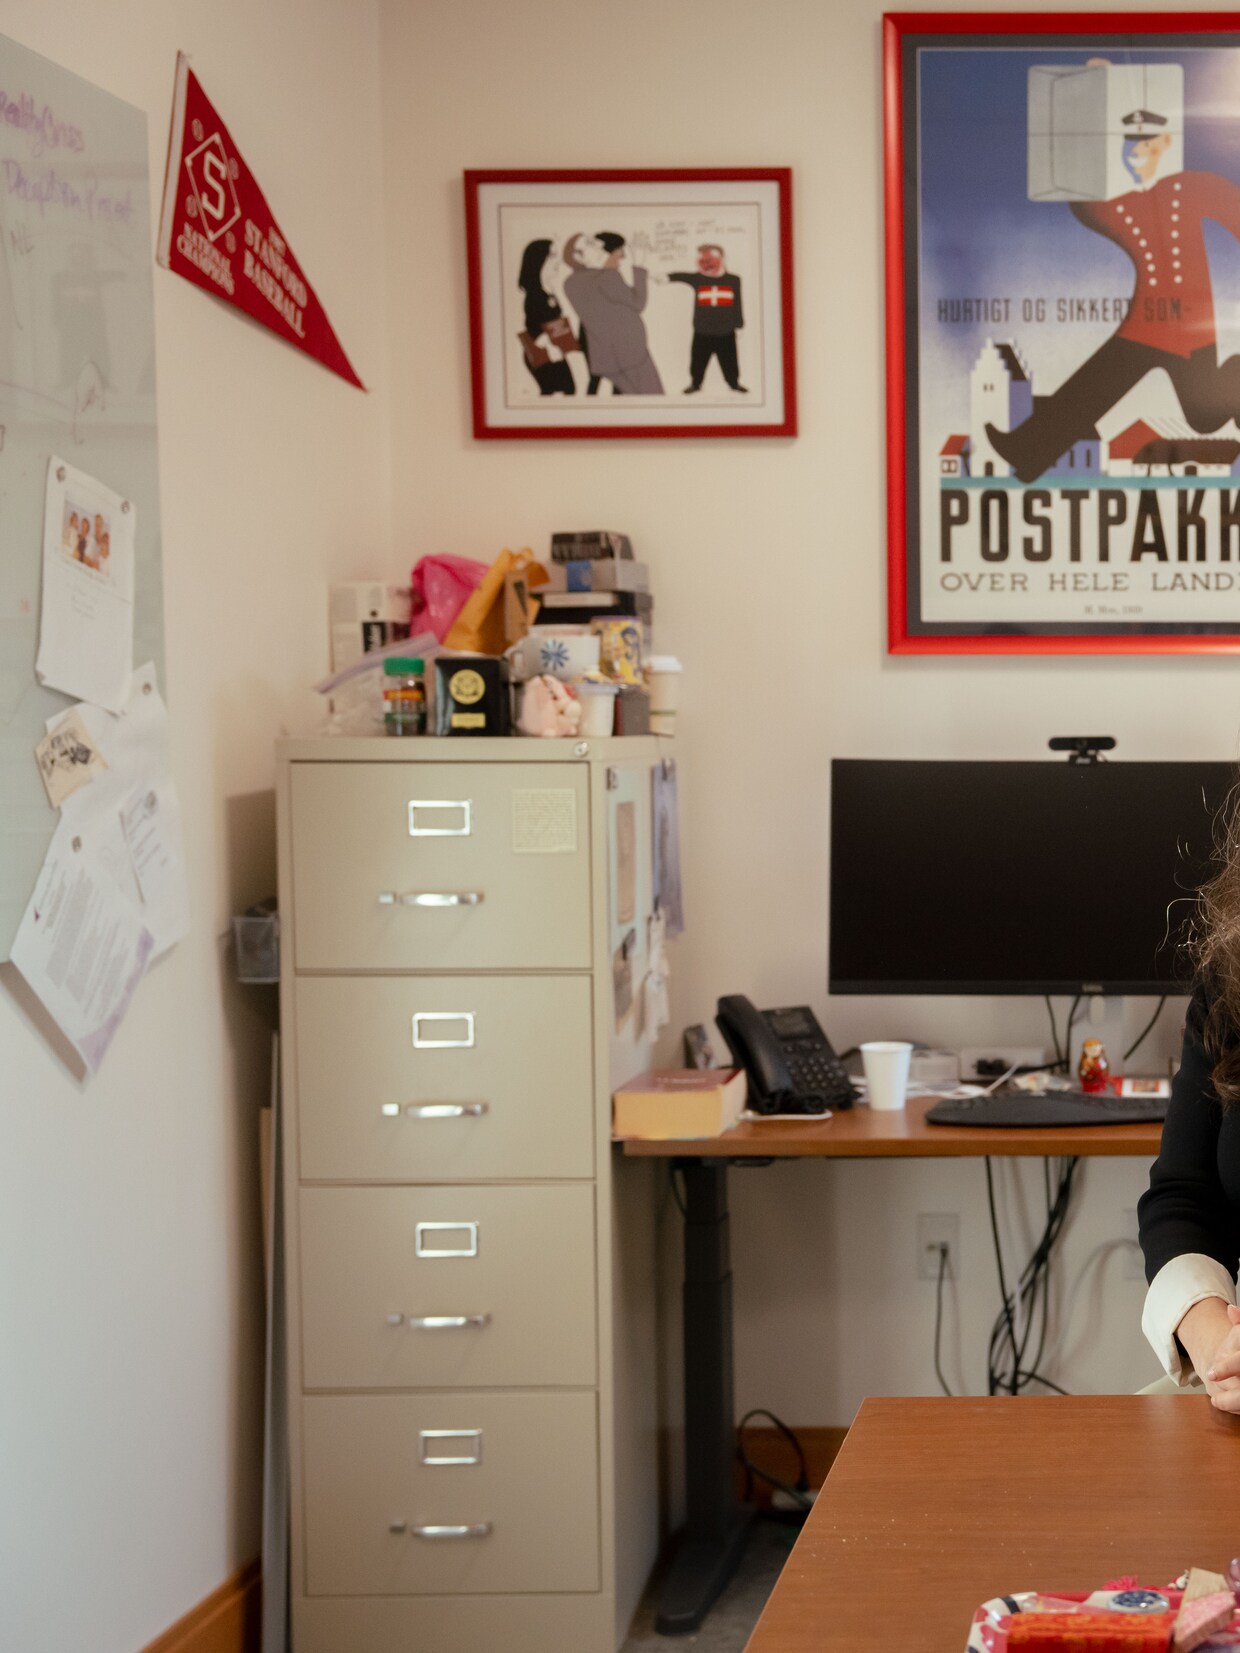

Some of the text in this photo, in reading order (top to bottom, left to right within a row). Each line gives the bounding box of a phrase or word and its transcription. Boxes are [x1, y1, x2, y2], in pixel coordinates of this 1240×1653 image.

[201, 150, 226, 221] S
[243, 248, 305, 339] BASEBALL
[244, 218, 308, 308] STANFORD
[938, 298, 1011, 323] HURTIGT
[1022, 298, 1046, 323] OG
[1057, 298, 1133, 323] SIKKERT
[940, 572, 1029, 592] OVER
[1049, 572, 1130, 592] HELE
